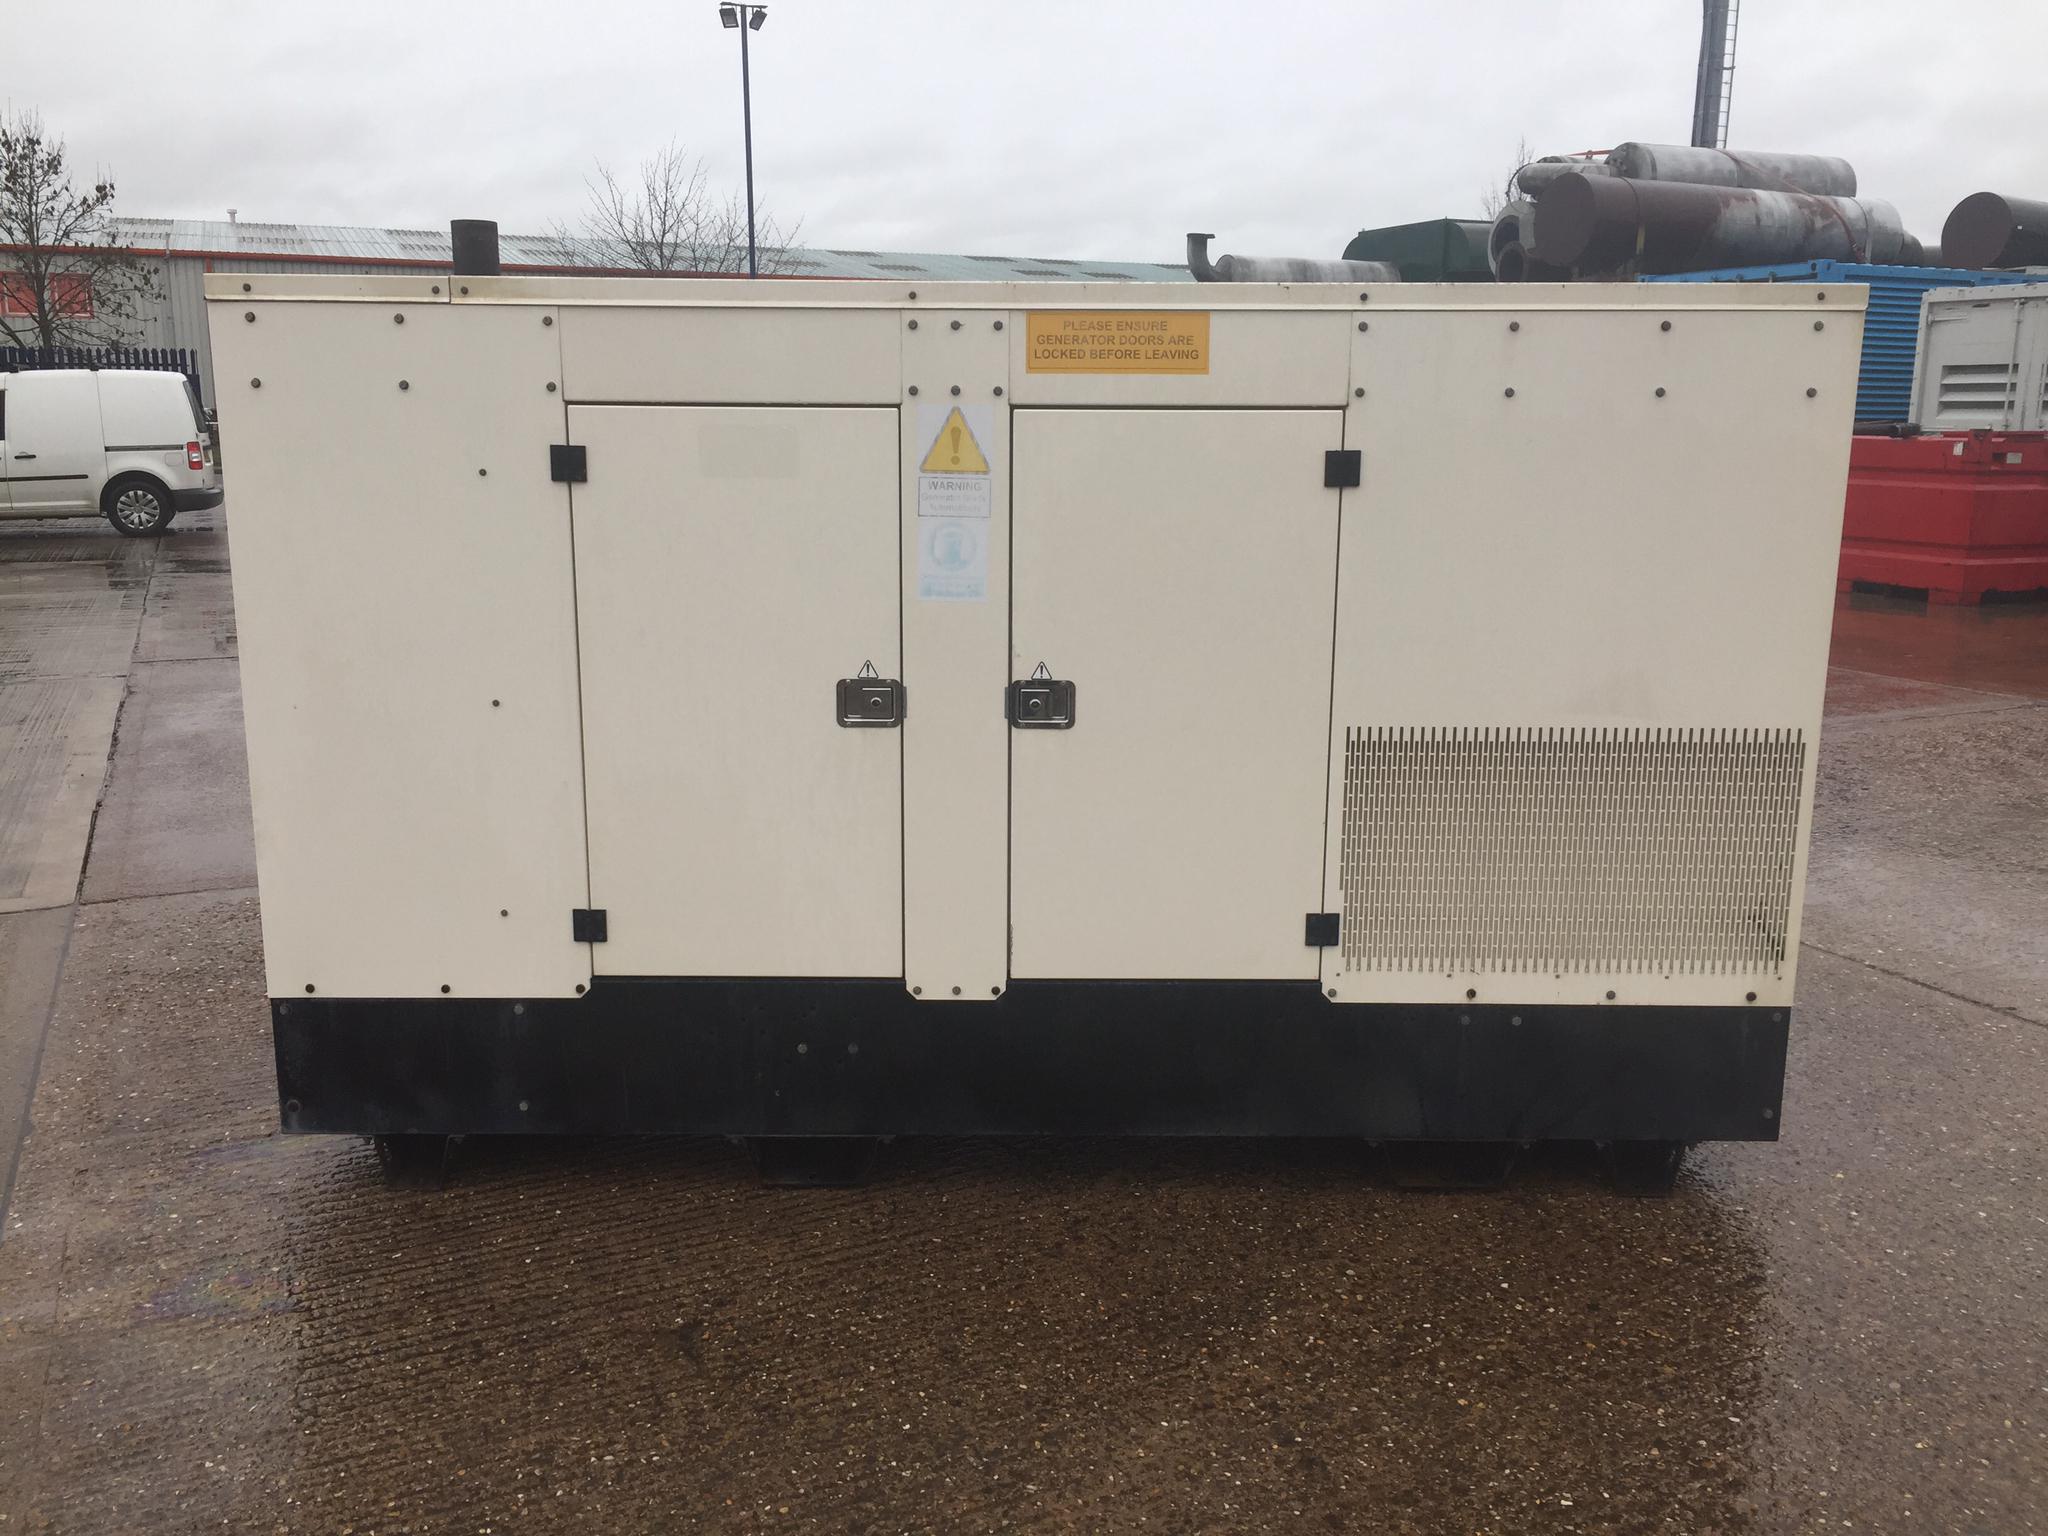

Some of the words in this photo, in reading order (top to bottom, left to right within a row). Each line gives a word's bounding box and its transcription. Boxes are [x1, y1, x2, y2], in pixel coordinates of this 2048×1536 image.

[1063, 320, 1112, 331] PLEASE
[1116, 320, 1168, 331] ENSURE
[1036, 334, 1116, 345] GENERATOR
[1119, 334, 1165, 346] DOORS
[1168, 335, 1194, 346] ARE
[1034, 349, 1085, 360] LOCKED
[1090, 349, 1141, 360] BEFORE
[1145, 349, 1199, 360] LEAVING
[928, 480, 983, 491] WARNING
